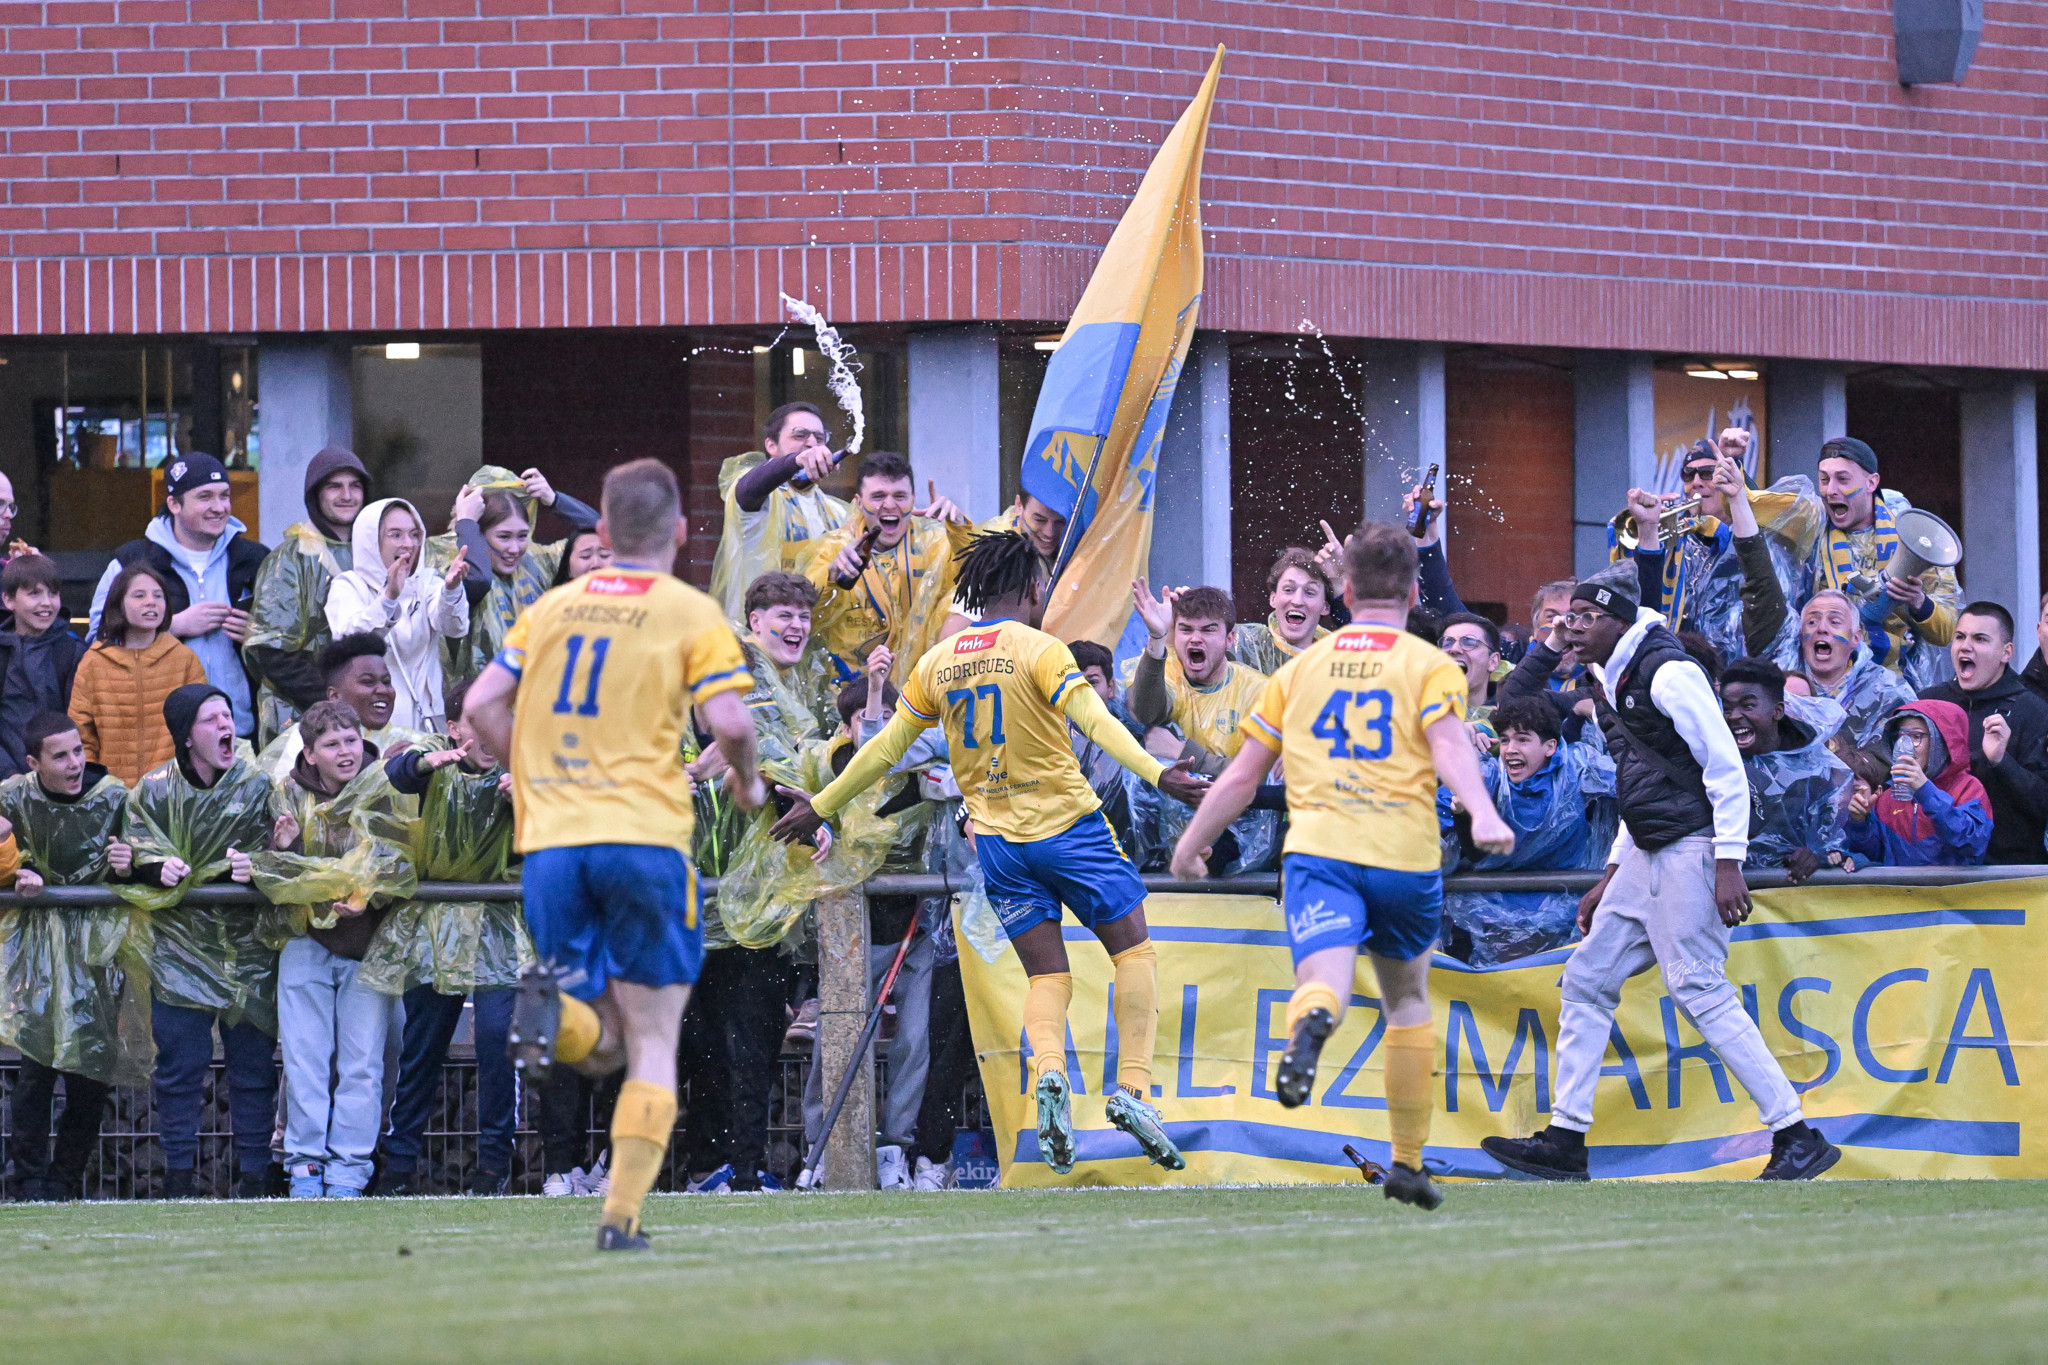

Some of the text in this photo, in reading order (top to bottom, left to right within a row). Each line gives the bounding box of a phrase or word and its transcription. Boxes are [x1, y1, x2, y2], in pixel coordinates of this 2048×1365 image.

[552, 636, 611, 716] 11
[936, 658, 1015, 686] RODRIGUES
[958, 636, 983, 651] mh
[1329, 661, 1384, 679] HELD
[945, 683, 1007, 749] 77
[1311, 688, 1394, 760] 43
[1019, 982, 1389, 1110] ALLEZ
